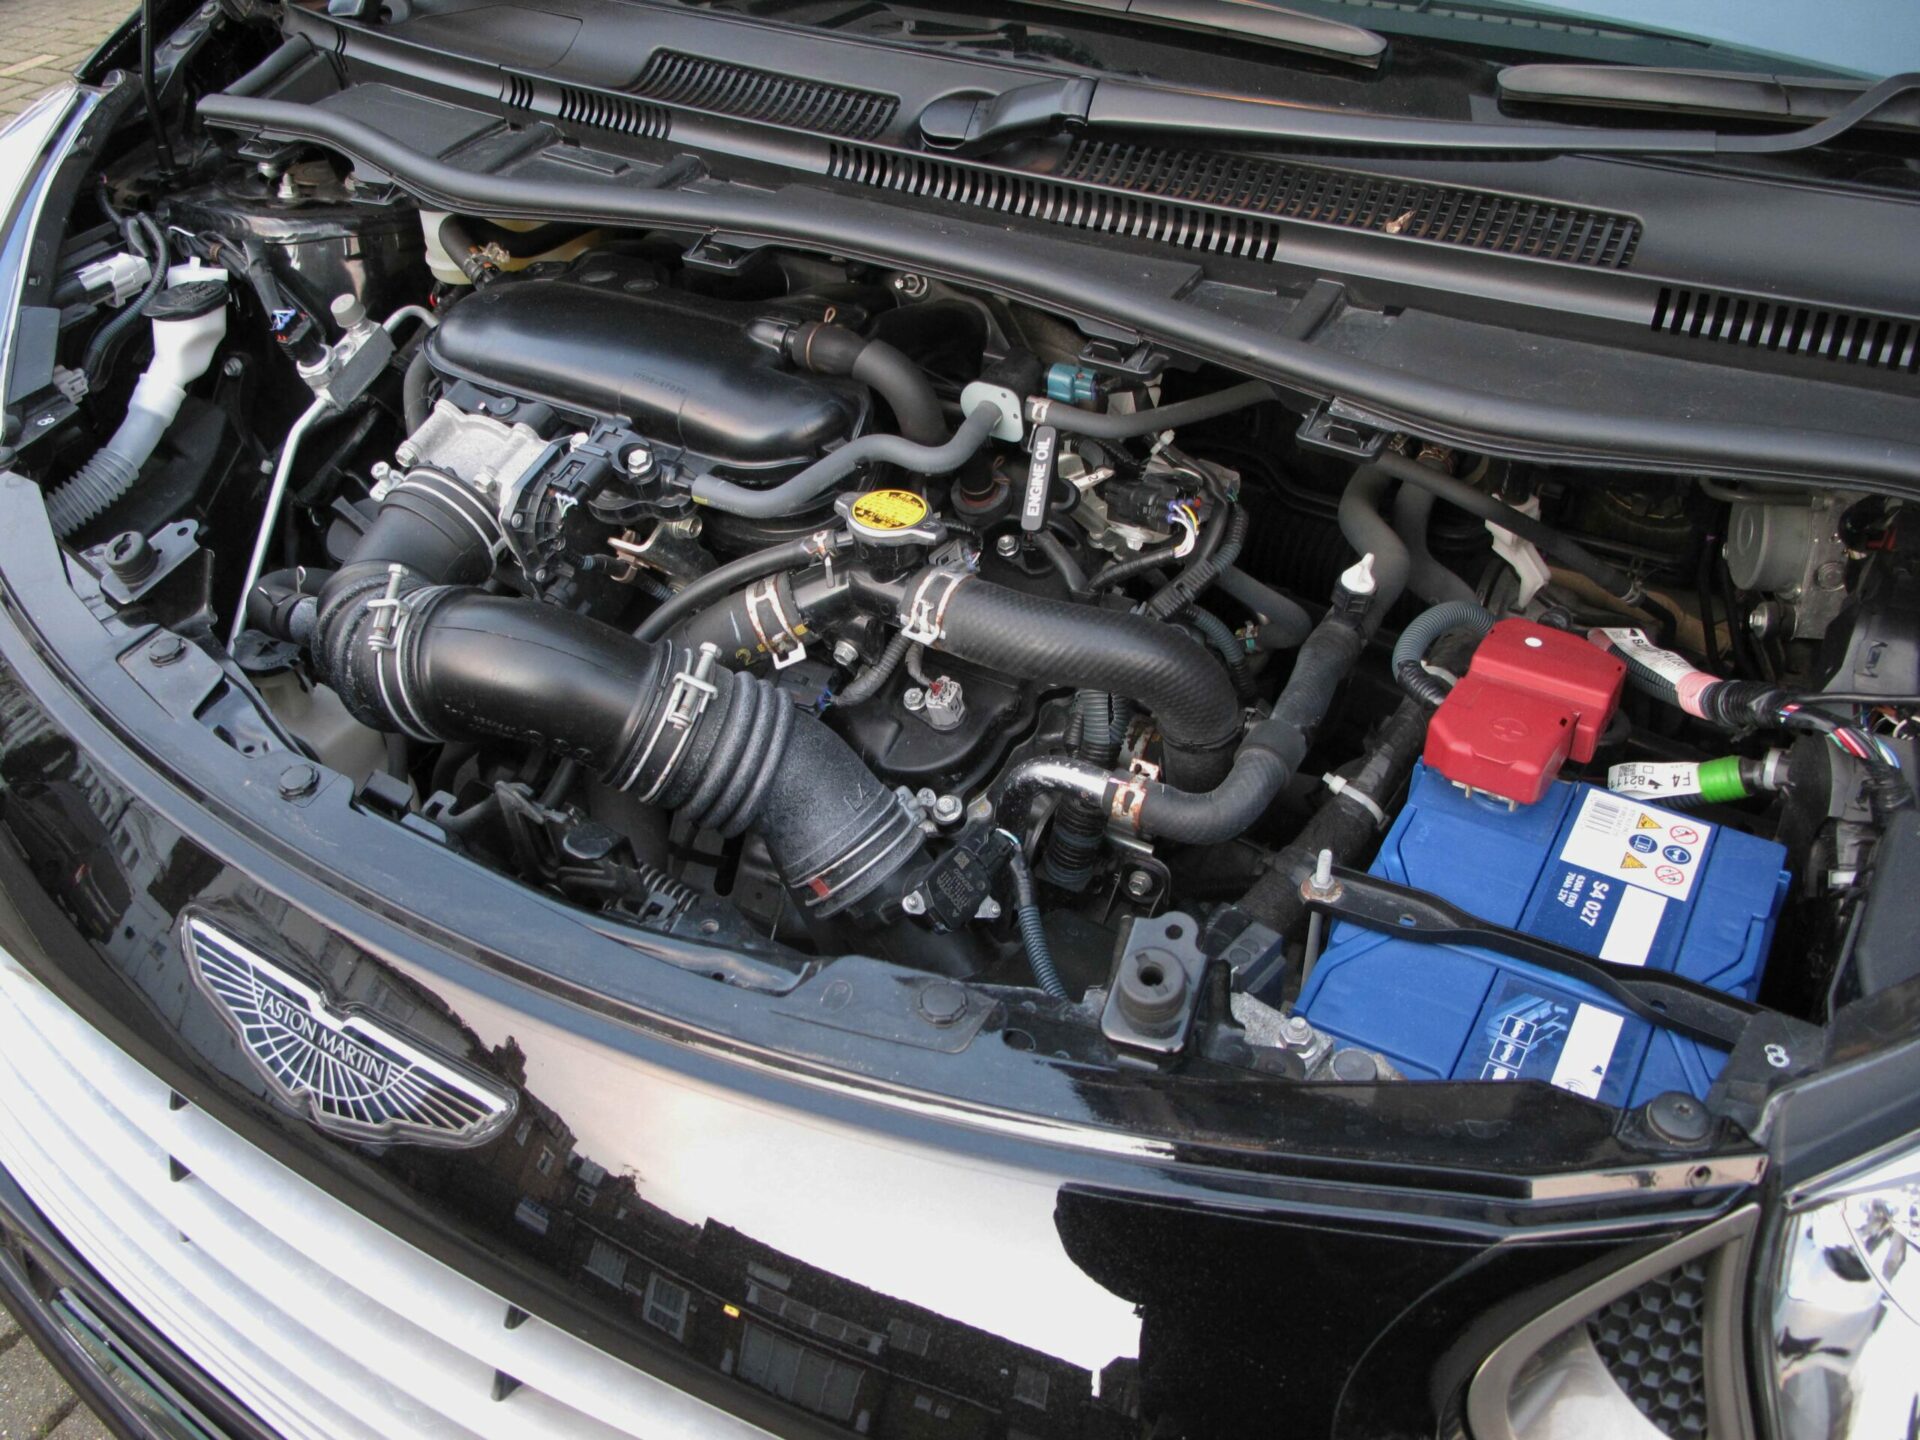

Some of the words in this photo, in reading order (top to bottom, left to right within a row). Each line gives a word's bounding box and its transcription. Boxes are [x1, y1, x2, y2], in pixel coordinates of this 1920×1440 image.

[1035, 437, 1051, 460] OIL
[1027, 463, 1046, 516] ENGINE
[1671, 771, 1691, 787] F4
[1589, 881, 1609, 900] S4
[1579, 901, 1602, 927] 027
[263, 996, 317, 1041] ASTON
[318, 1029, 385, 1082] MARTIN
